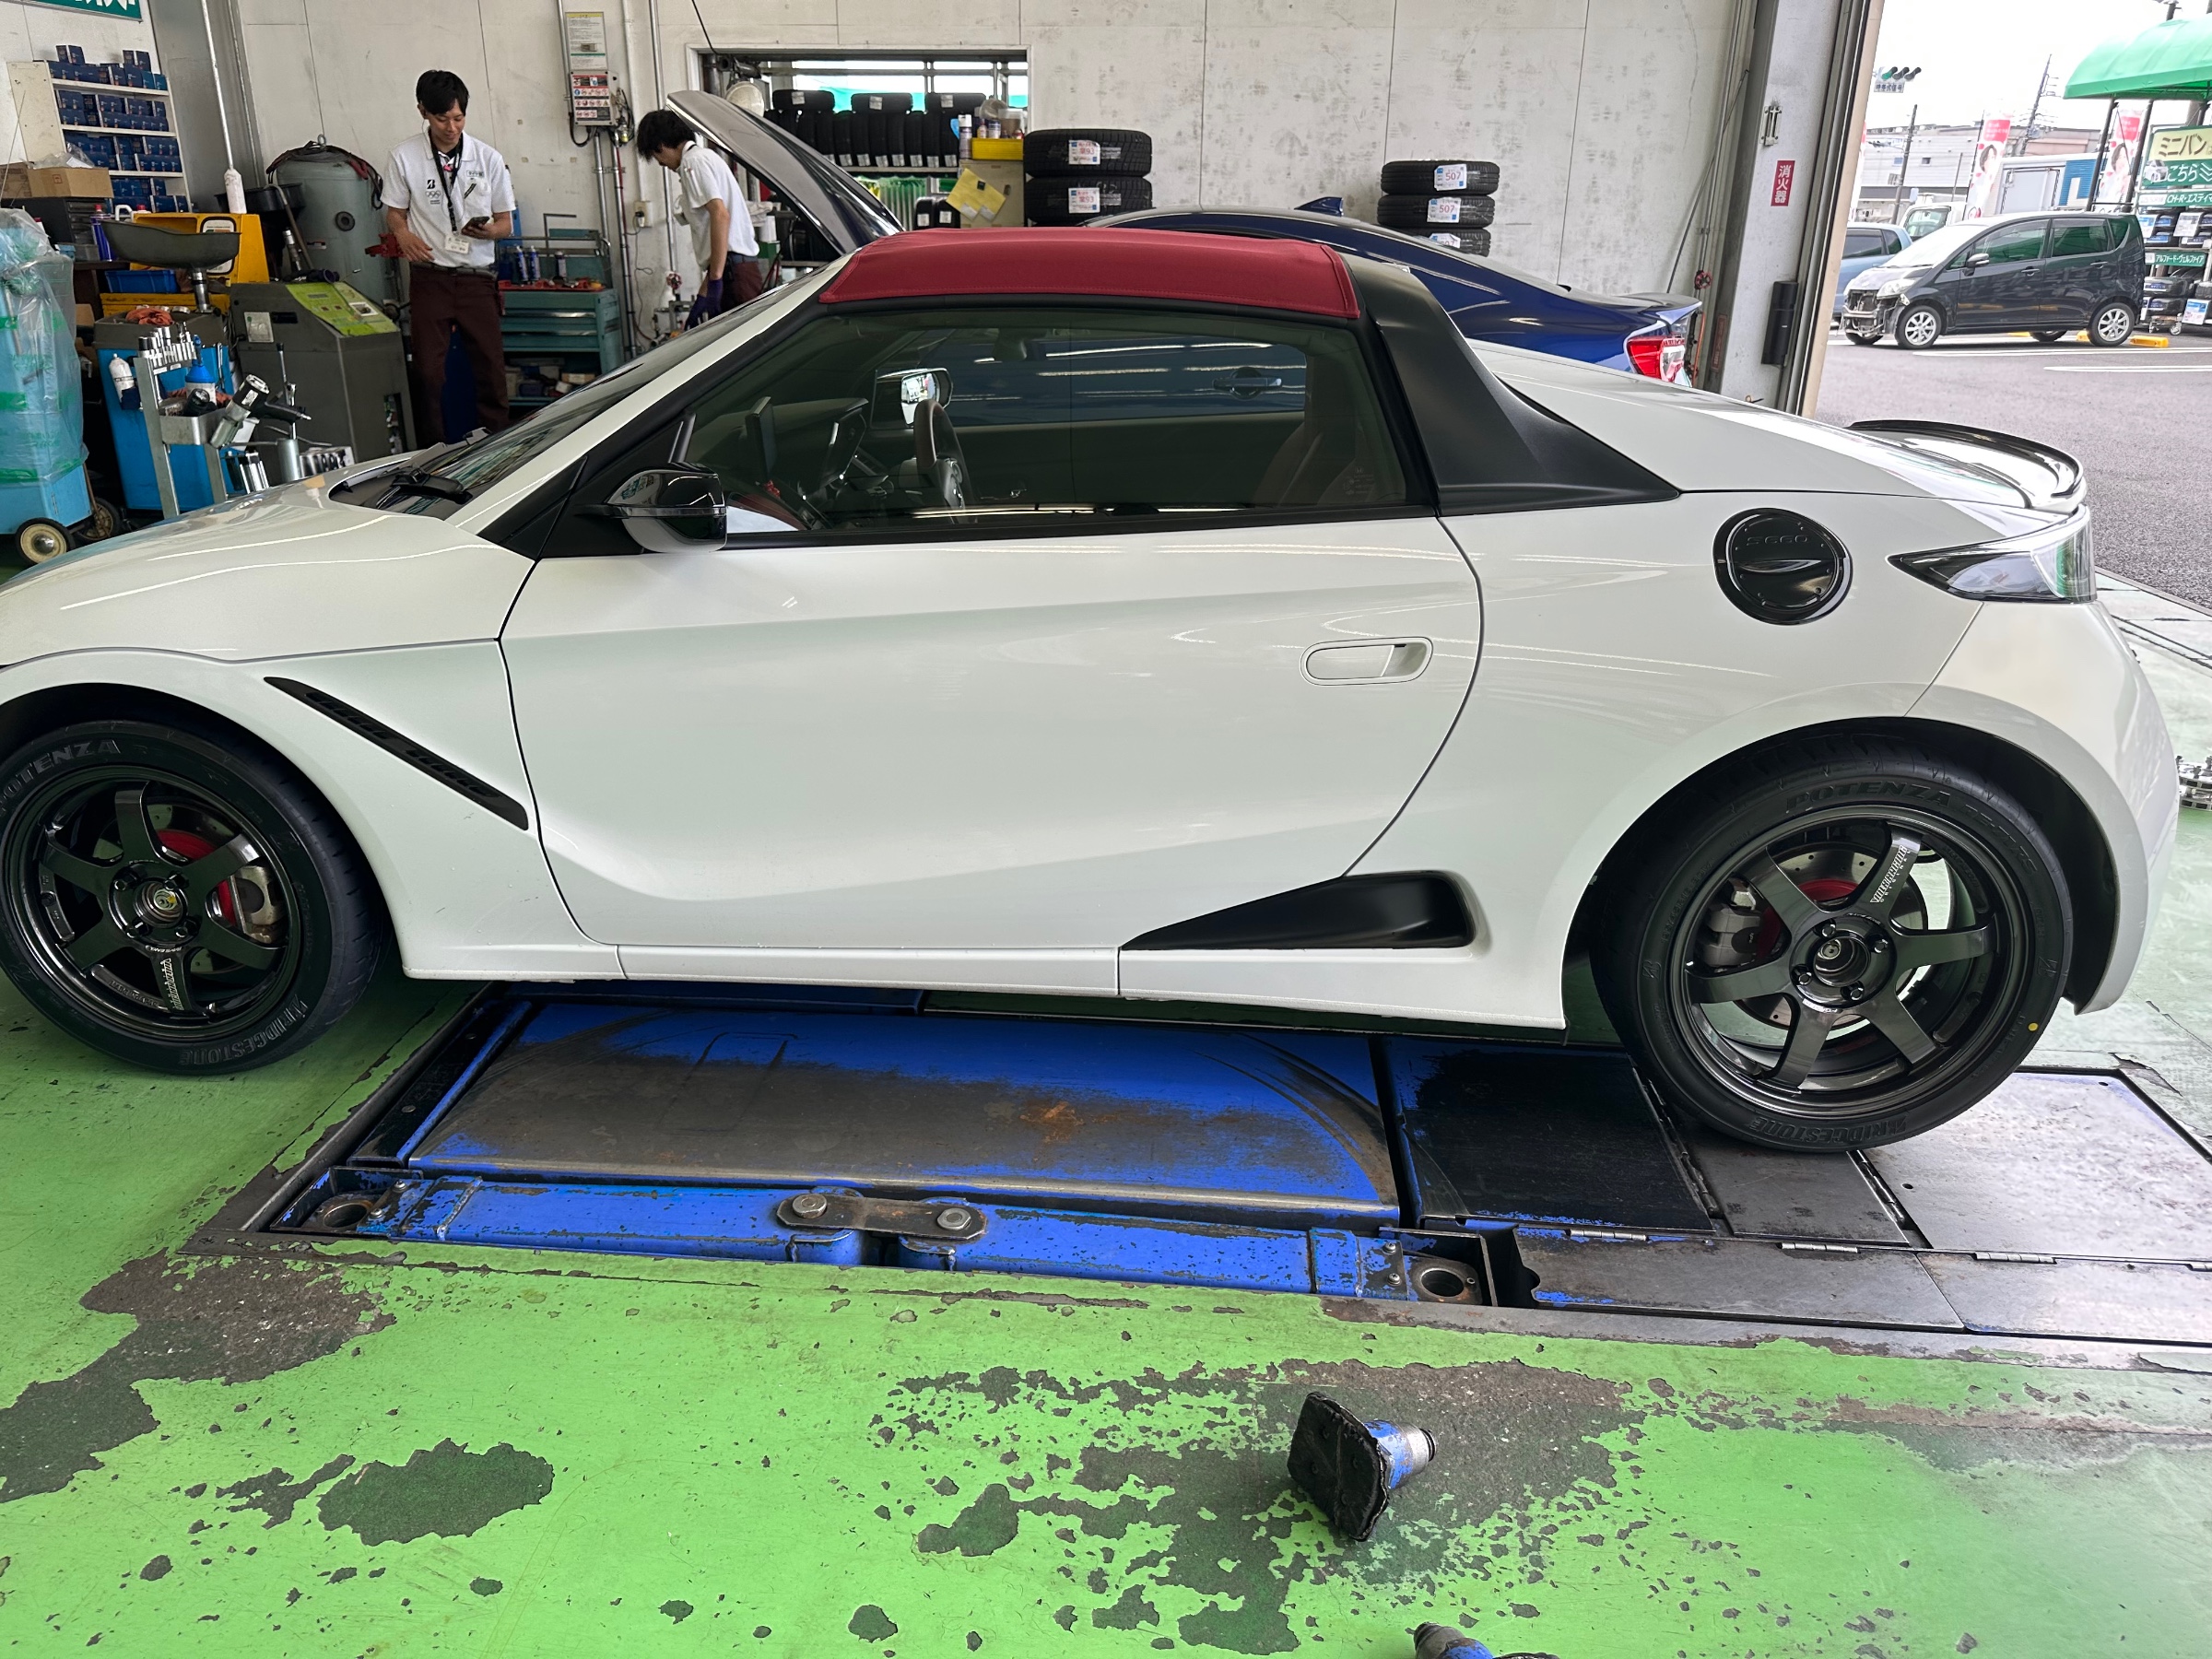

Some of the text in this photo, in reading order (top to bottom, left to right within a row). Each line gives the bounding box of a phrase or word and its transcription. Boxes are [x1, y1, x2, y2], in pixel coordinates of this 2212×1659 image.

[1445, 172, 1461, 181] 507
[1774, 164, 1792, 204] 消火器
[2167, 164, 2199, 182] こちら
[1439, 205, 1455, 213] 507
[1746, 535, 1808, 547] S660
[1785, 781, 1951, 814] POTENZA
[179, 994, 309, 1065] BRIDGESTONE
[1749, 1114, 1909, 1144] BRIDGESTONE
